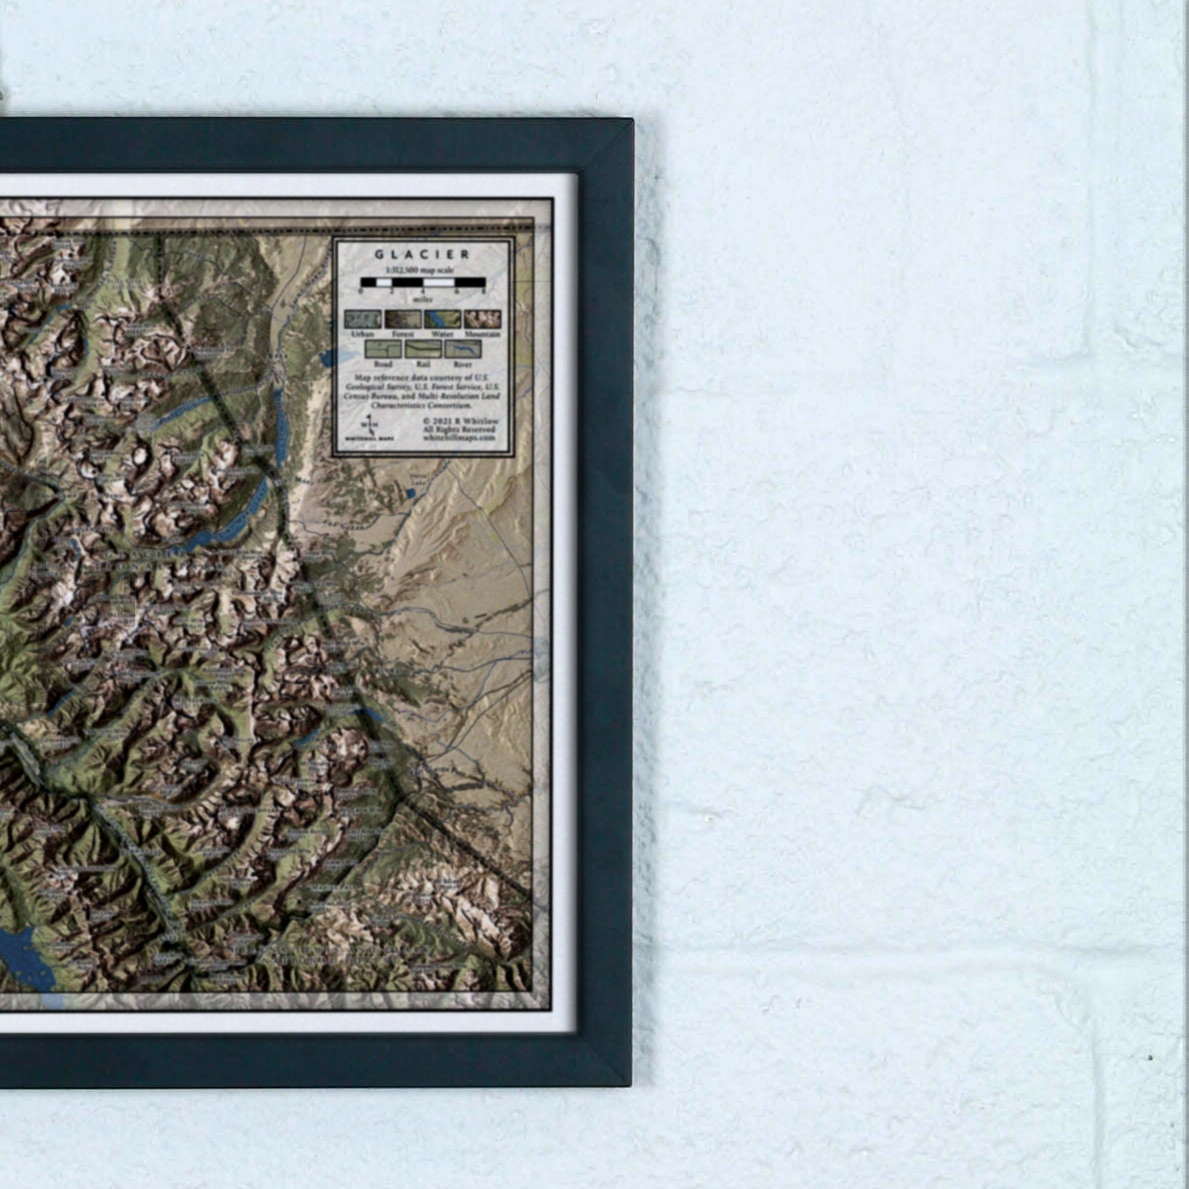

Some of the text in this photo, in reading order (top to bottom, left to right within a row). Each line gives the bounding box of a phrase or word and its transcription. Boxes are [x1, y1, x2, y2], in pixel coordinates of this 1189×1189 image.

[374, 249, 470, 260] GLACIER
[420, 267, 436, 276] map
[436, 266, 454, 274] scale
[413, 295, 434, 303] miles
[351, 330, 501, 338] Urban Forest Water Mountain
[374, 361, 473, 369] Road Rail River
[354, 374, 372, 383] Map
[373, 374, 409, 382] reference
[411, 374, 428, 382] data
[429, 374, 463, 383] courtesy
[464, 374, 474, 382] of
[345, 383, 385, 392] Geological
[386, 383, 413, 392] Survey,
[431, 383, 454, 391] Forest
[455, 383, 484, 392] Service,
[343, 392, 369, 400] Census
[370, 392, 401, 401] Bureau,
[401, 392, 417, 400] and
[481, 392, 501, 400] Land
[370, 401, 472, 410] Characteristics Consortium.
[463, 417, 499, 425] Whitlow
[423, 425, 496, 435] All Rights Reserved
[423, 434, 496, 443] whitehillmaps.com
